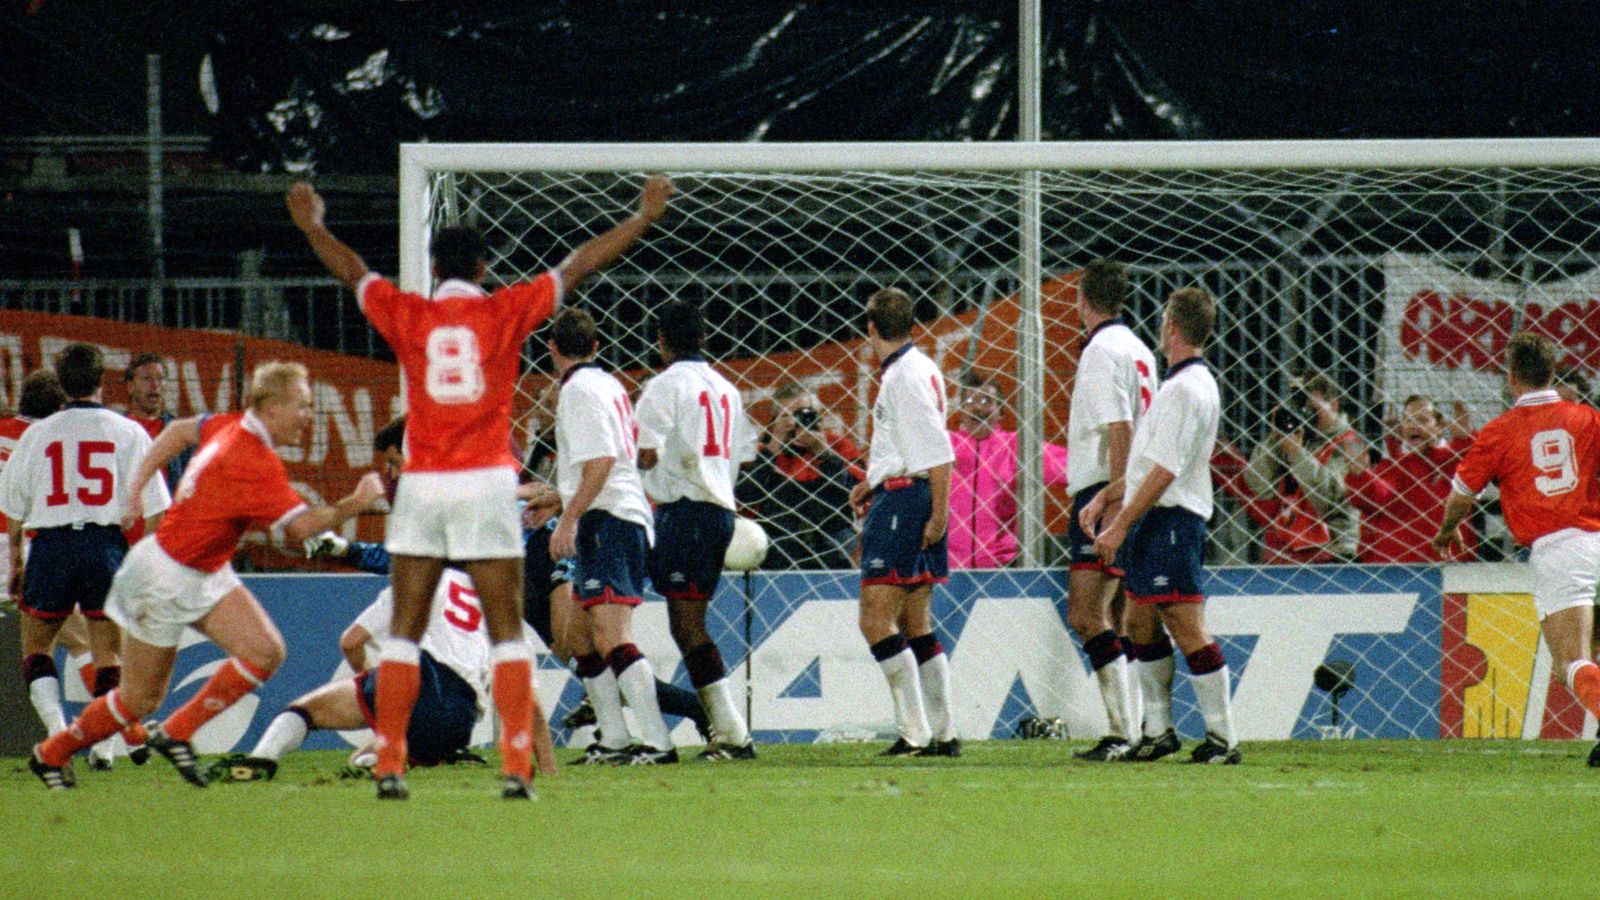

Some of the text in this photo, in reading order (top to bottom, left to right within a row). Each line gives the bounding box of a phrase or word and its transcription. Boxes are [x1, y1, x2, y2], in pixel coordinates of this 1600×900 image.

[426, 325, 485, 404] 8
[698, 390, 731, 460] 11
[45, 440, 116, 507] 15
[1530, 428, 1579, 497] 9
[443, 580, 482, 633] 5
